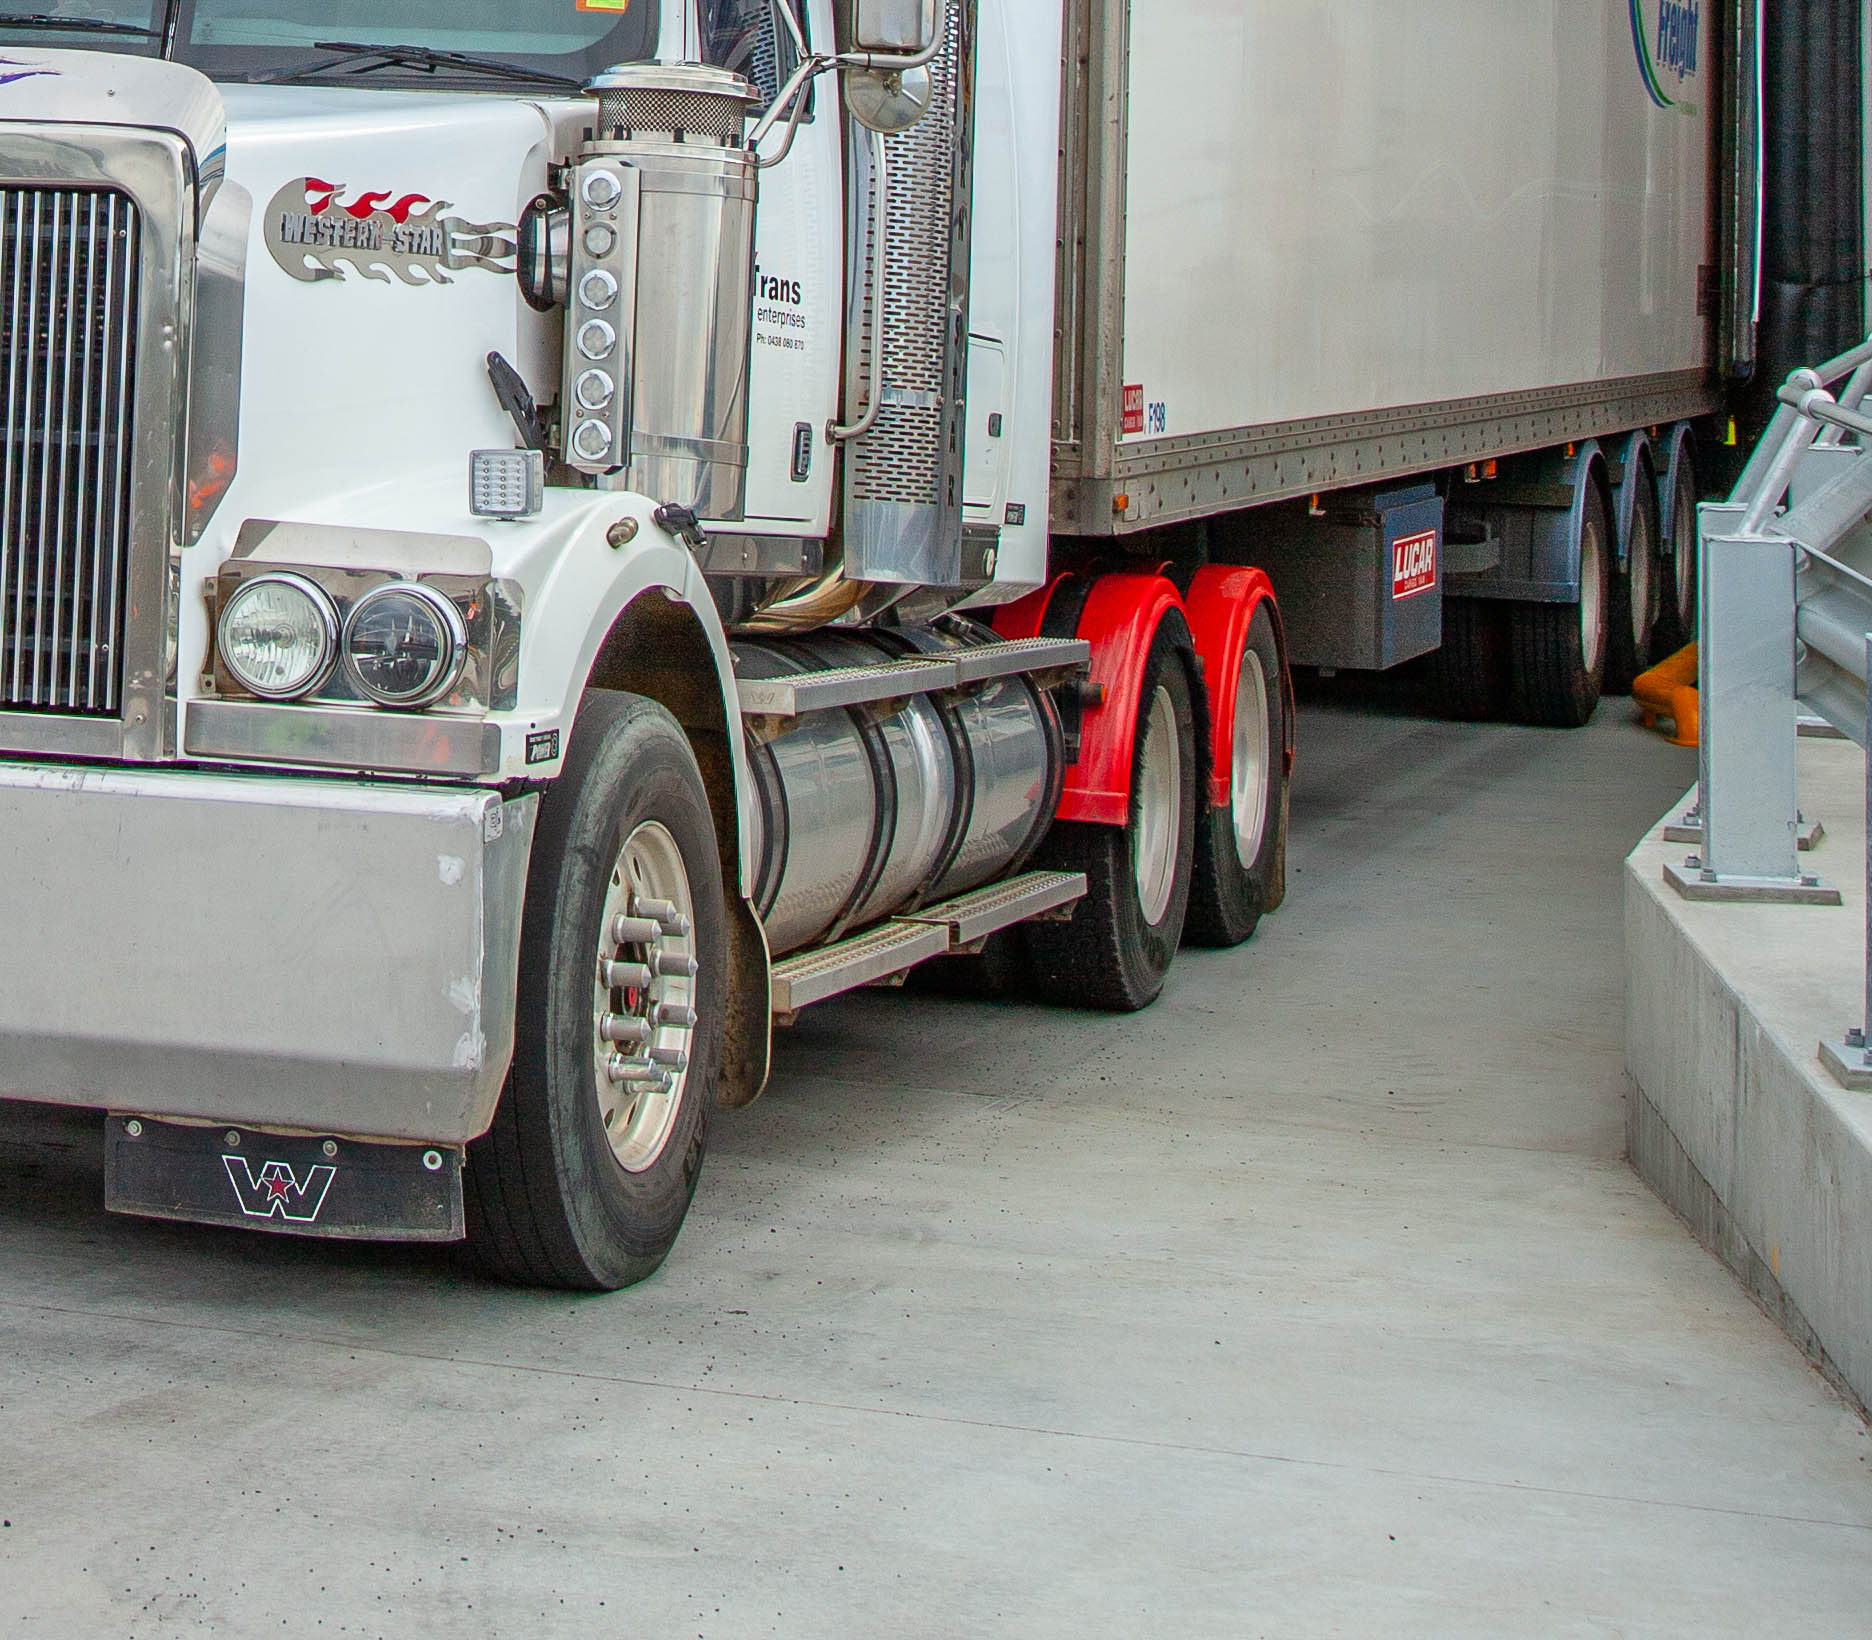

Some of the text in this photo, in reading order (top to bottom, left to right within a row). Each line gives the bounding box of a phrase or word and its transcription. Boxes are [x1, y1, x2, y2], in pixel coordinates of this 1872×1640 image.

[280, 212, 443, 256] WESTERN STAR
[757, 307, 806, 328] enterprises
[1394, 538, 1433, 581] LUCAR
